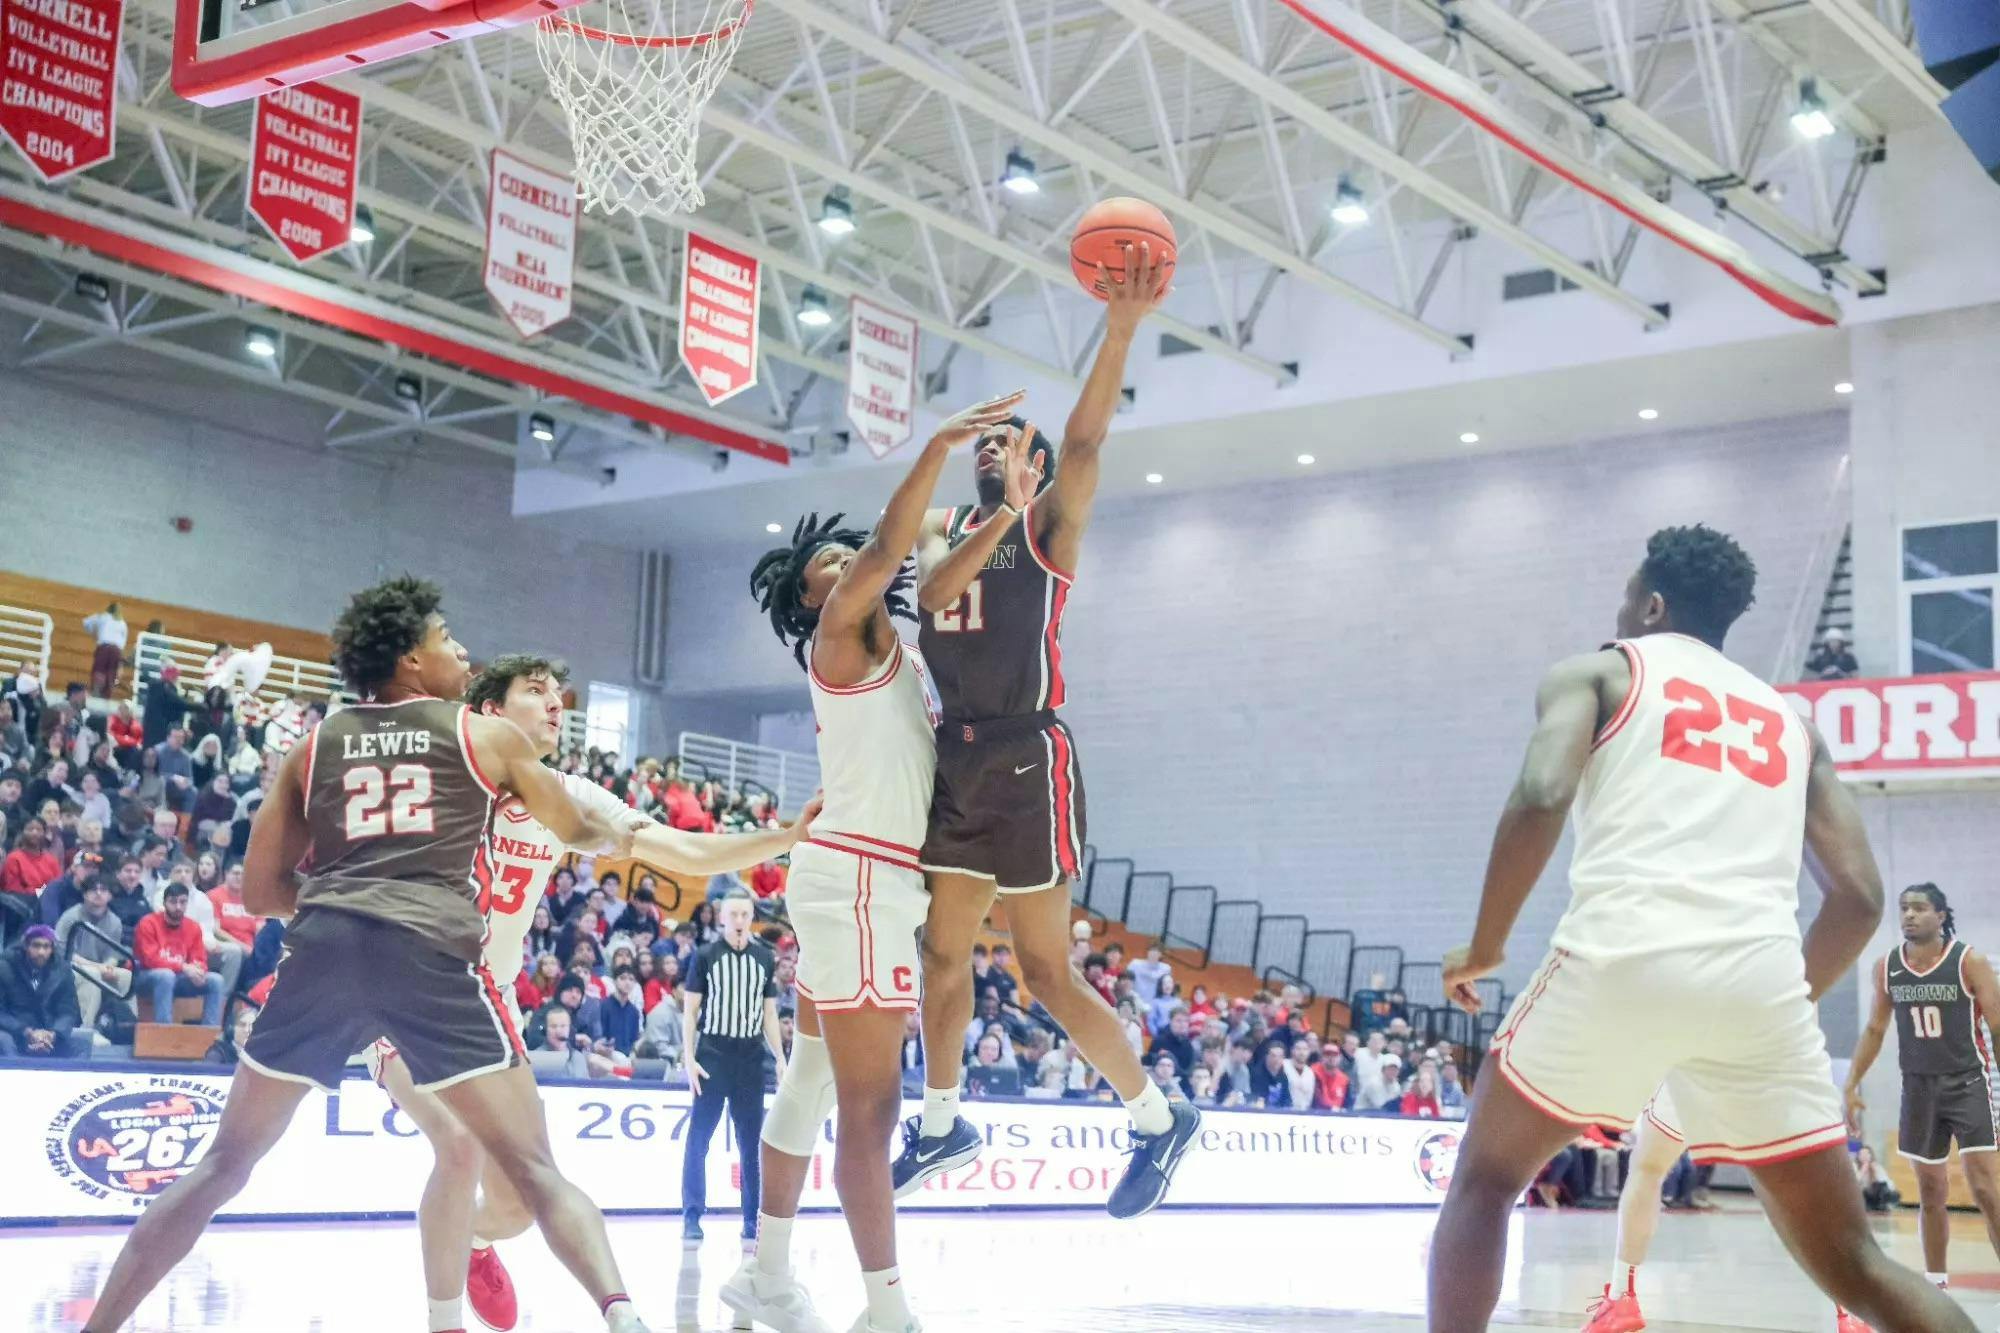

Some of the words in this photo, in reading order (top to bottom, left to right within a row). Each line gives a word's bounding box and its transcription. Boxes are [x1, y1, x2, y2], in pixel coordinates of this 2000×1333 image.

[8, 13, 109, 71] VOLLEYBALL
[7, 46, 37, 75] IVY
[41, 60, 103, 100] LEAGUE
[3, 78, 105, 138] CHAMPIONS
[26, 131, 74, 166] 2004
[265, 113, 351, 162] VOLLEYBALL
[265, 142, 289, 168] IVY
[293, 154, 346, 188] LEAGUE
[258, 169, 346, 224] CHAMPIONS
[500, 173, 571, 219] CORNELL
[934, 579, 984, 631] 21
[343, 730, 431, 760] LEWIS
[1661, 676, 1787, 788] 23
[343, 764, 435, 842] 22
[492, 834, 553, 861] RNELL
[492, 861, 533, 915] 3
[892, 965, 912, 993] C
[1889, 984, 1958, 1002] BROWN
[1909, 1006, 1942, 1038] 10
[107, 1123, 220, 1171] 267
[111, 1117, 161, 1130] LOCAL
[576, 1102, 692, 1140] 267
[1051, 1119, 1133, 1149] and
[1200, 1125, 1393, 1155] eamfitters
